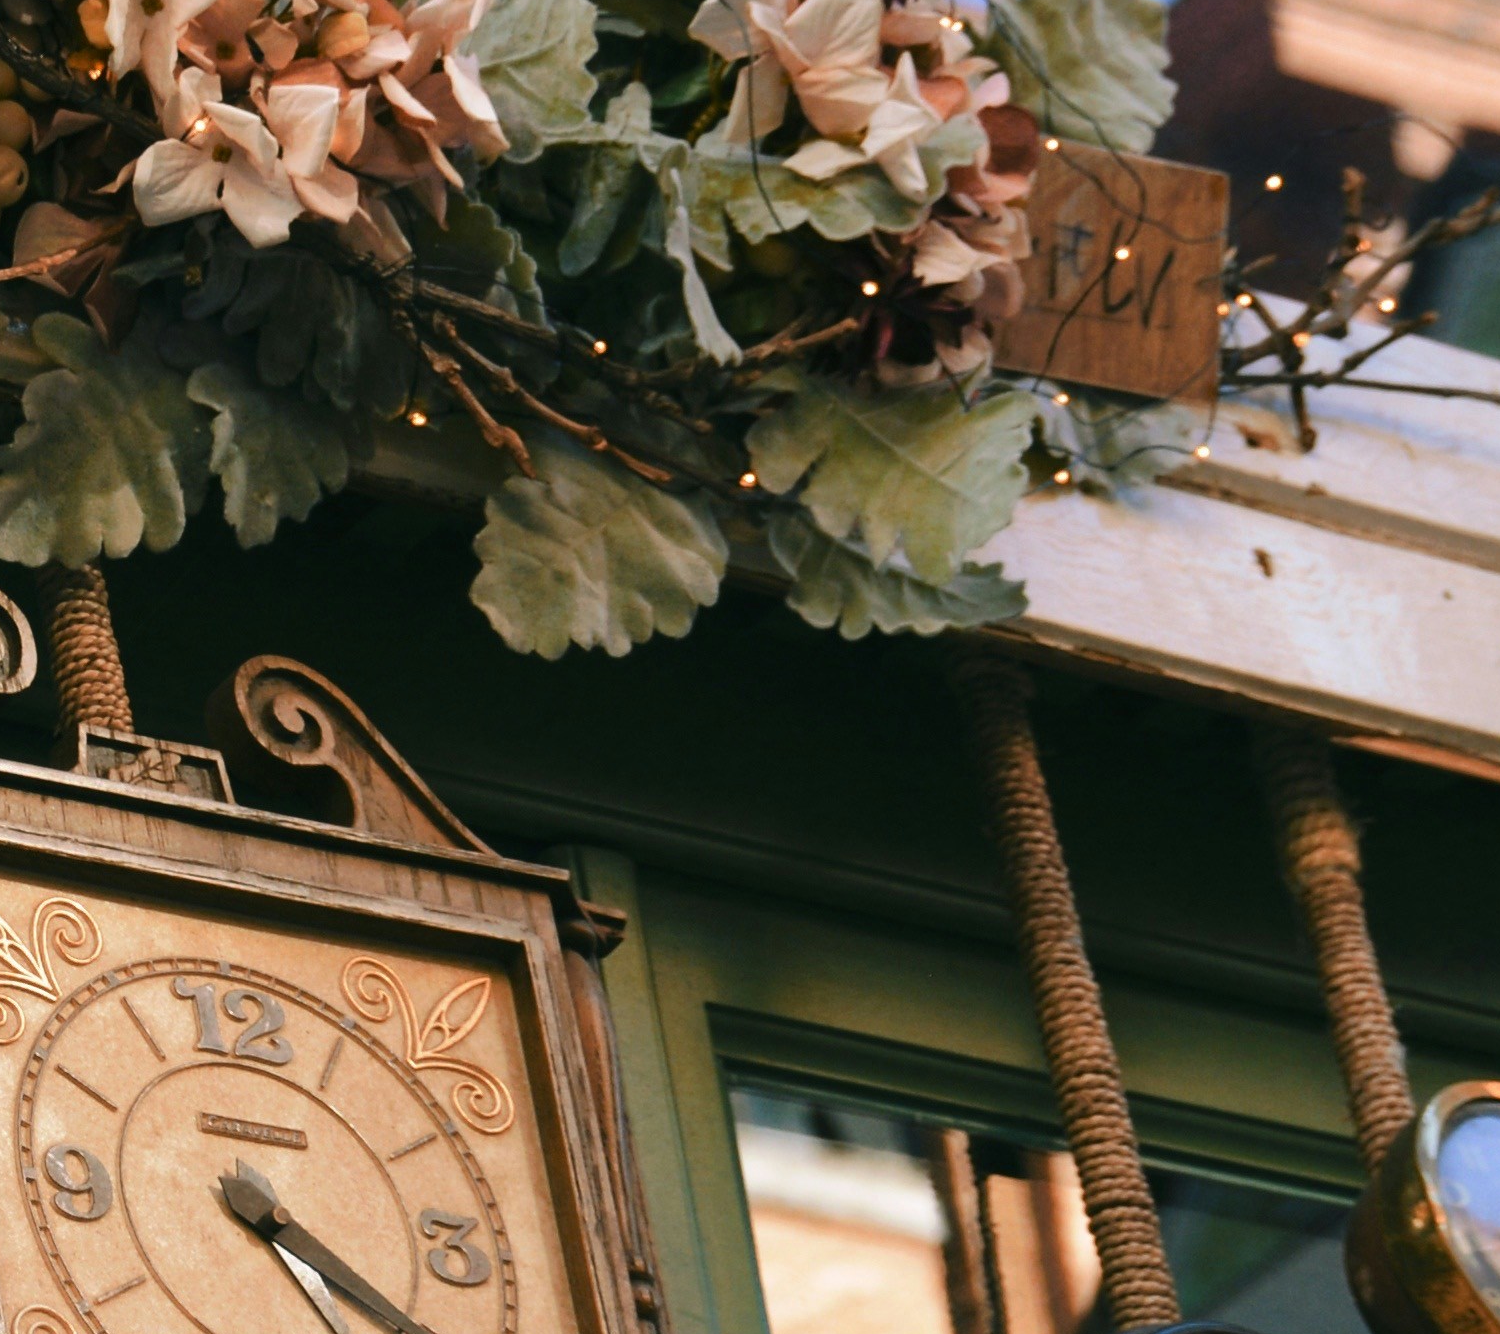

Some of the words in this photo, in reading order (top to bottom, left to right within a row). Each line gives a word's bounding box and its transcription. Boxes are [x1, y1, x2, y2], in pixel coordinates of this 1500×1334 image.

[171, 975, 293, 1066] 12
[43, 1144, 114, 1222] 9
[418, 1208, 493, 1288] 3
